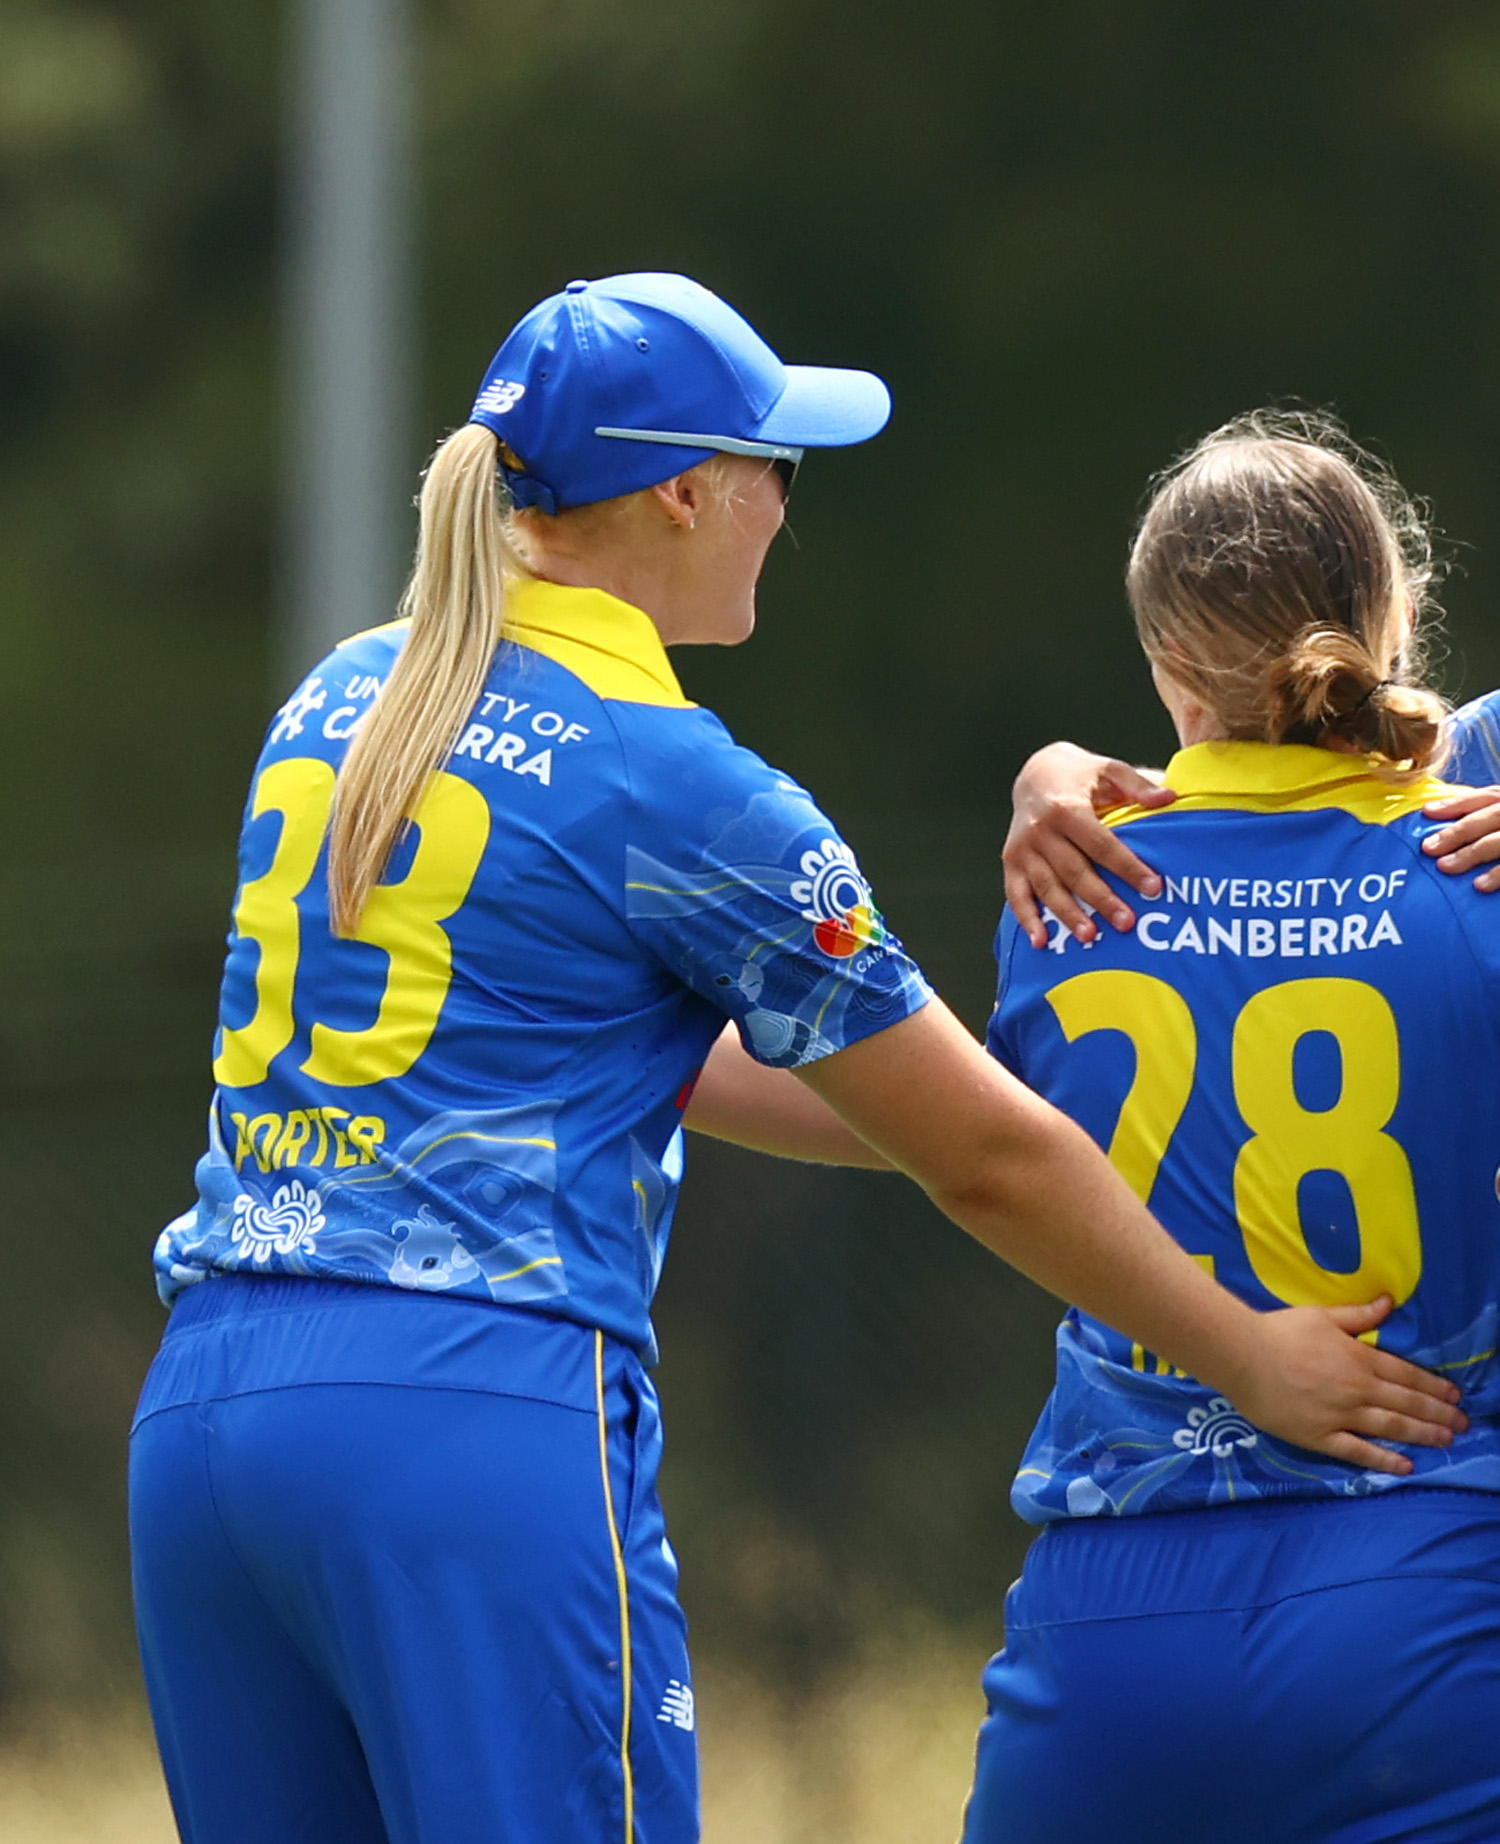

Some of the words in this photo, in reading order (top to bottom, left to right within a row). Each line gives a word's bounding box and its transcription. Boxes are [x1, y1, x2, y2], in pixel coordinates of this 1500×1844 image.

[530, 711, 590, 744] OF
[1140, 875, 1352, 908] NIVERSITY
[1357, 869, 1408, 902] OF
[213, 757, 491, 1088] 33
[1136, 909, 1403, 957] CANBERRA
[230, 1106, 386, 1174] PORTER
[1045, 969, 1423, 1309] 28
